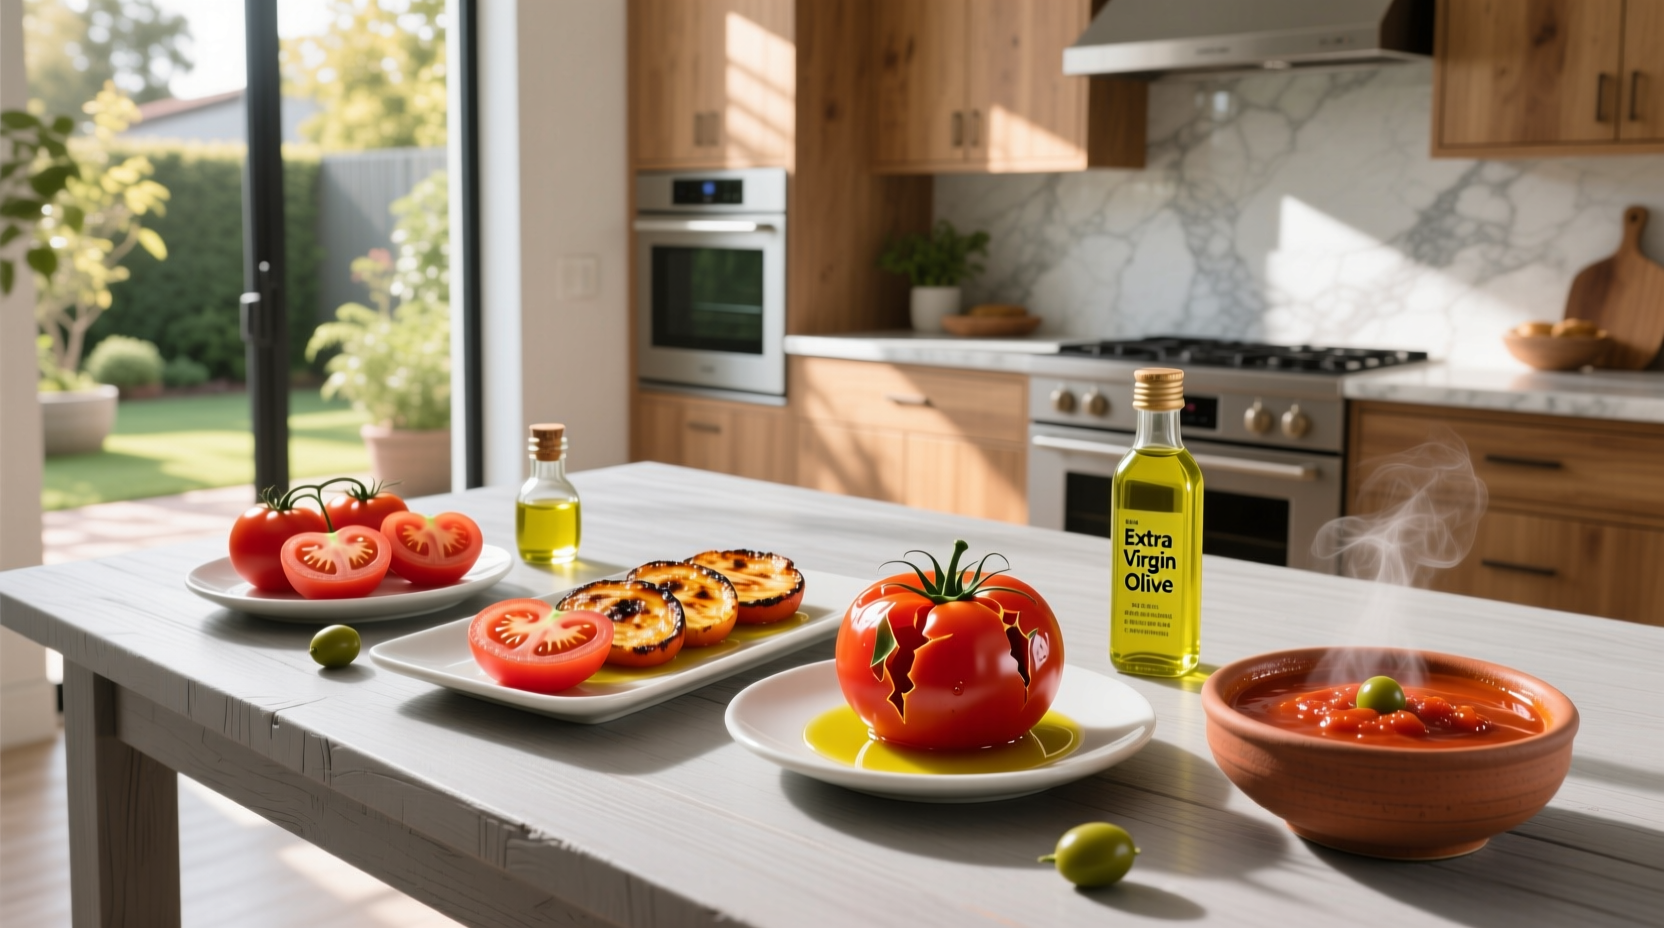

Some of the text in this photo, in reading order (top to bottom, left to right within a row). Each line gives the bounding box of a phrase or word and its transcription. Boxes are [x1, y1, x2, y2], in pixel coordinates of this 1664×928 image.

[1125, 528, 1172, 548] Extra
[1124, 549, 1176, 574] Virgin
[1125, 573, 1173, 593] Olive
